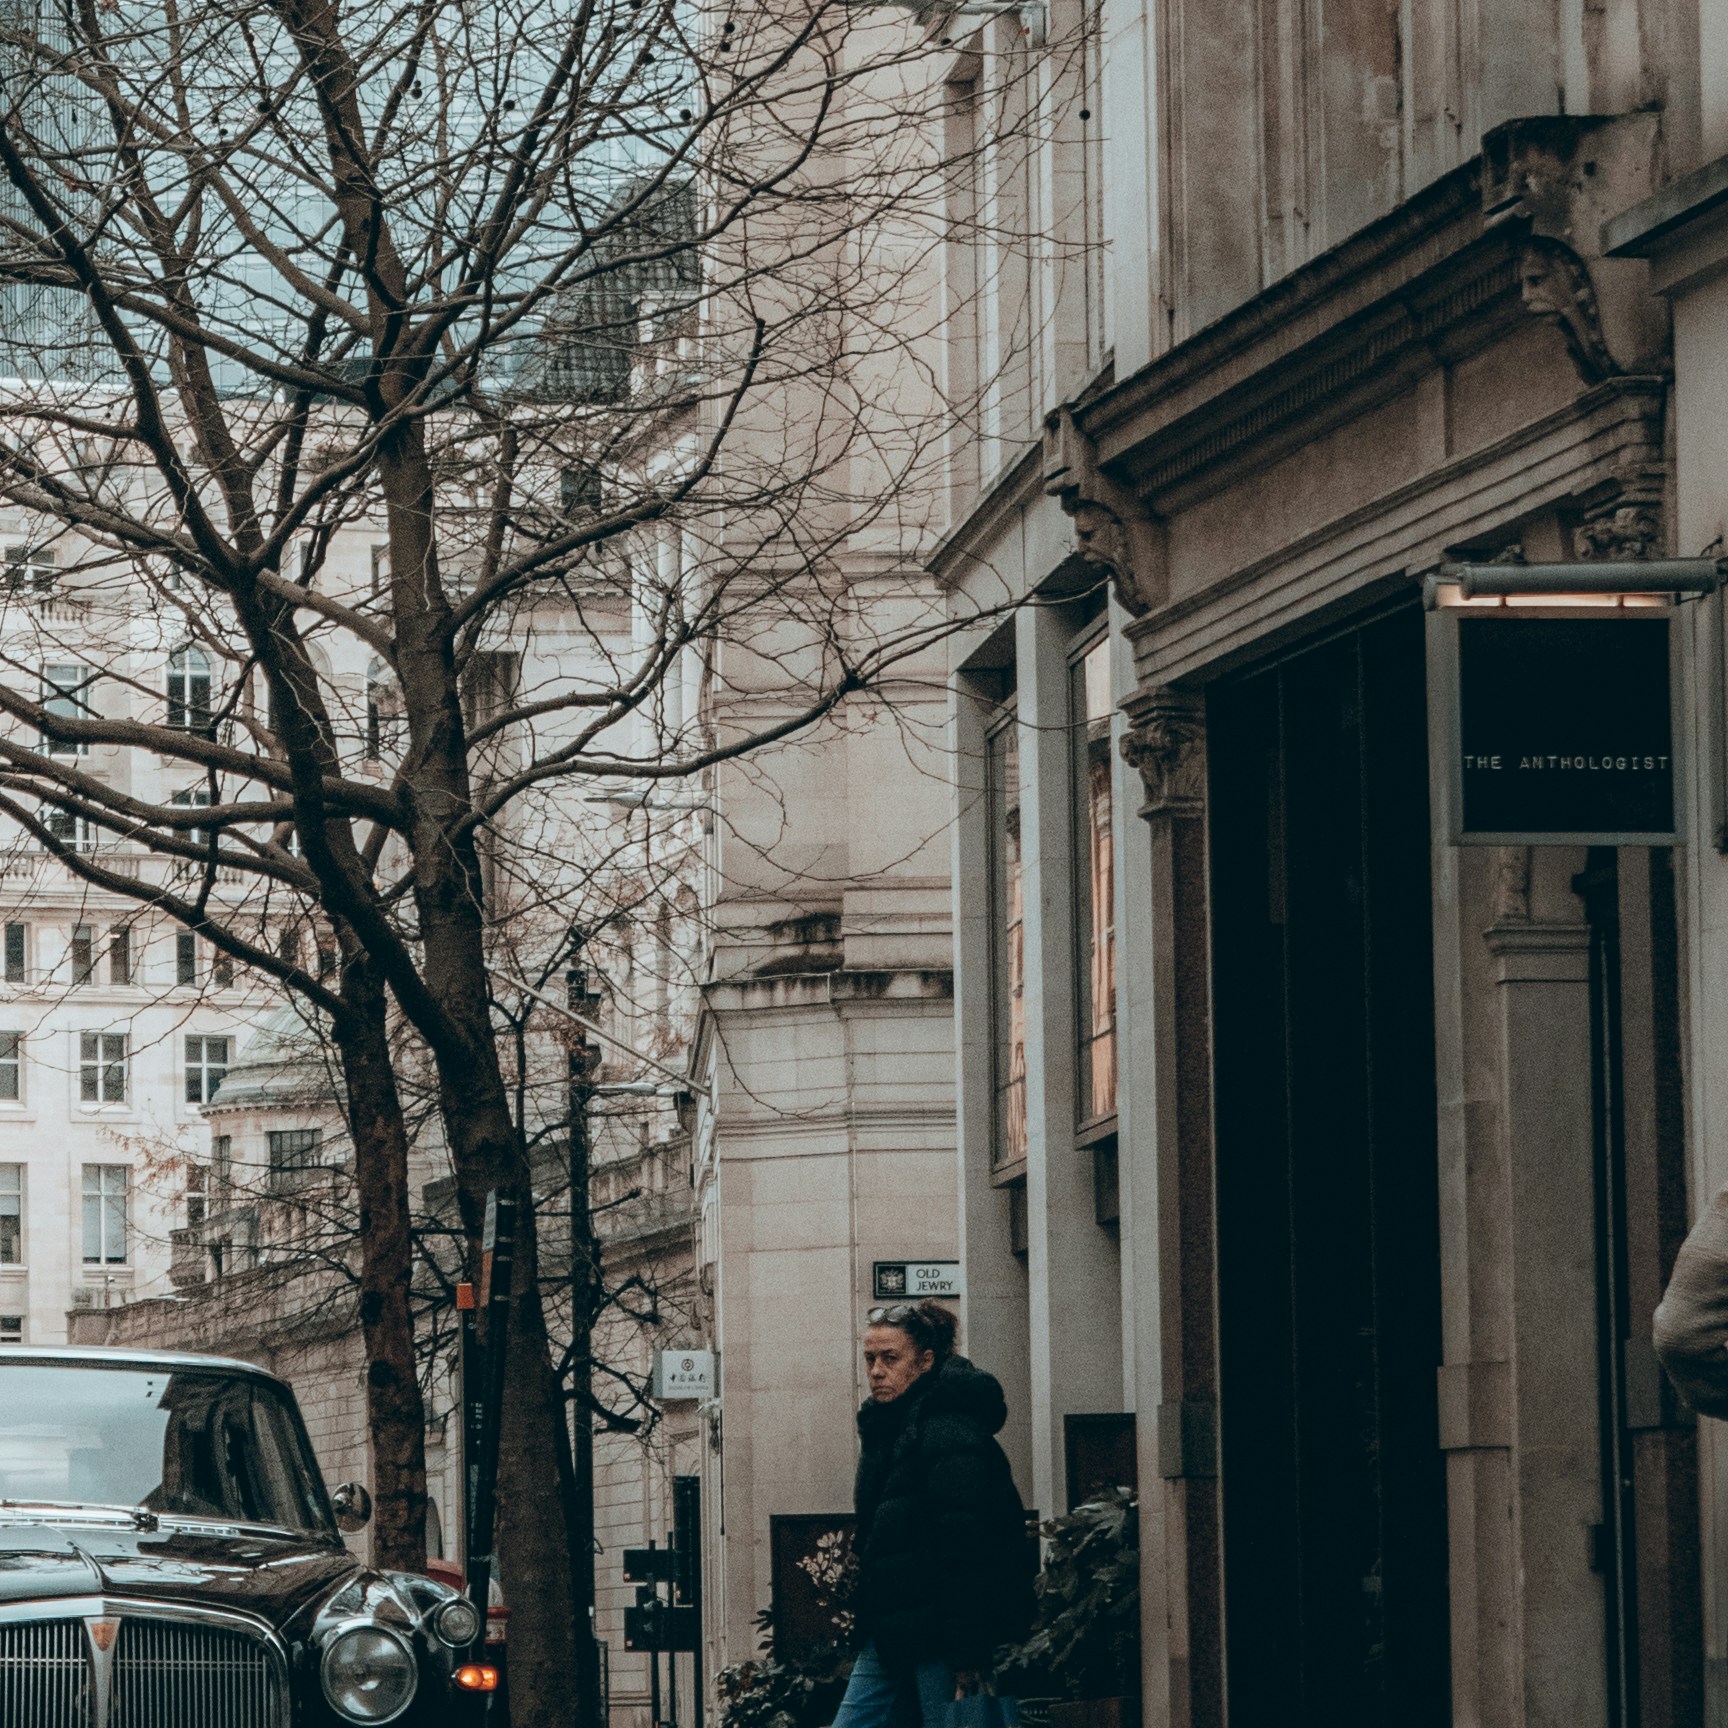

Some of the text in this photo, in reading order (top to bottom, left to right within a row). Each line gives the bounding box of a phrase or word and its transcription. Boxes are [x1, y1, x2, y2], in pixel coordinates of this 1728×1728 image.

[1464, 755, 1668, 770] THE ANTHOLOGIST
[916, 1268, 940, 1279] OLD
[916, 1281, 953, 1292] JEWRY
